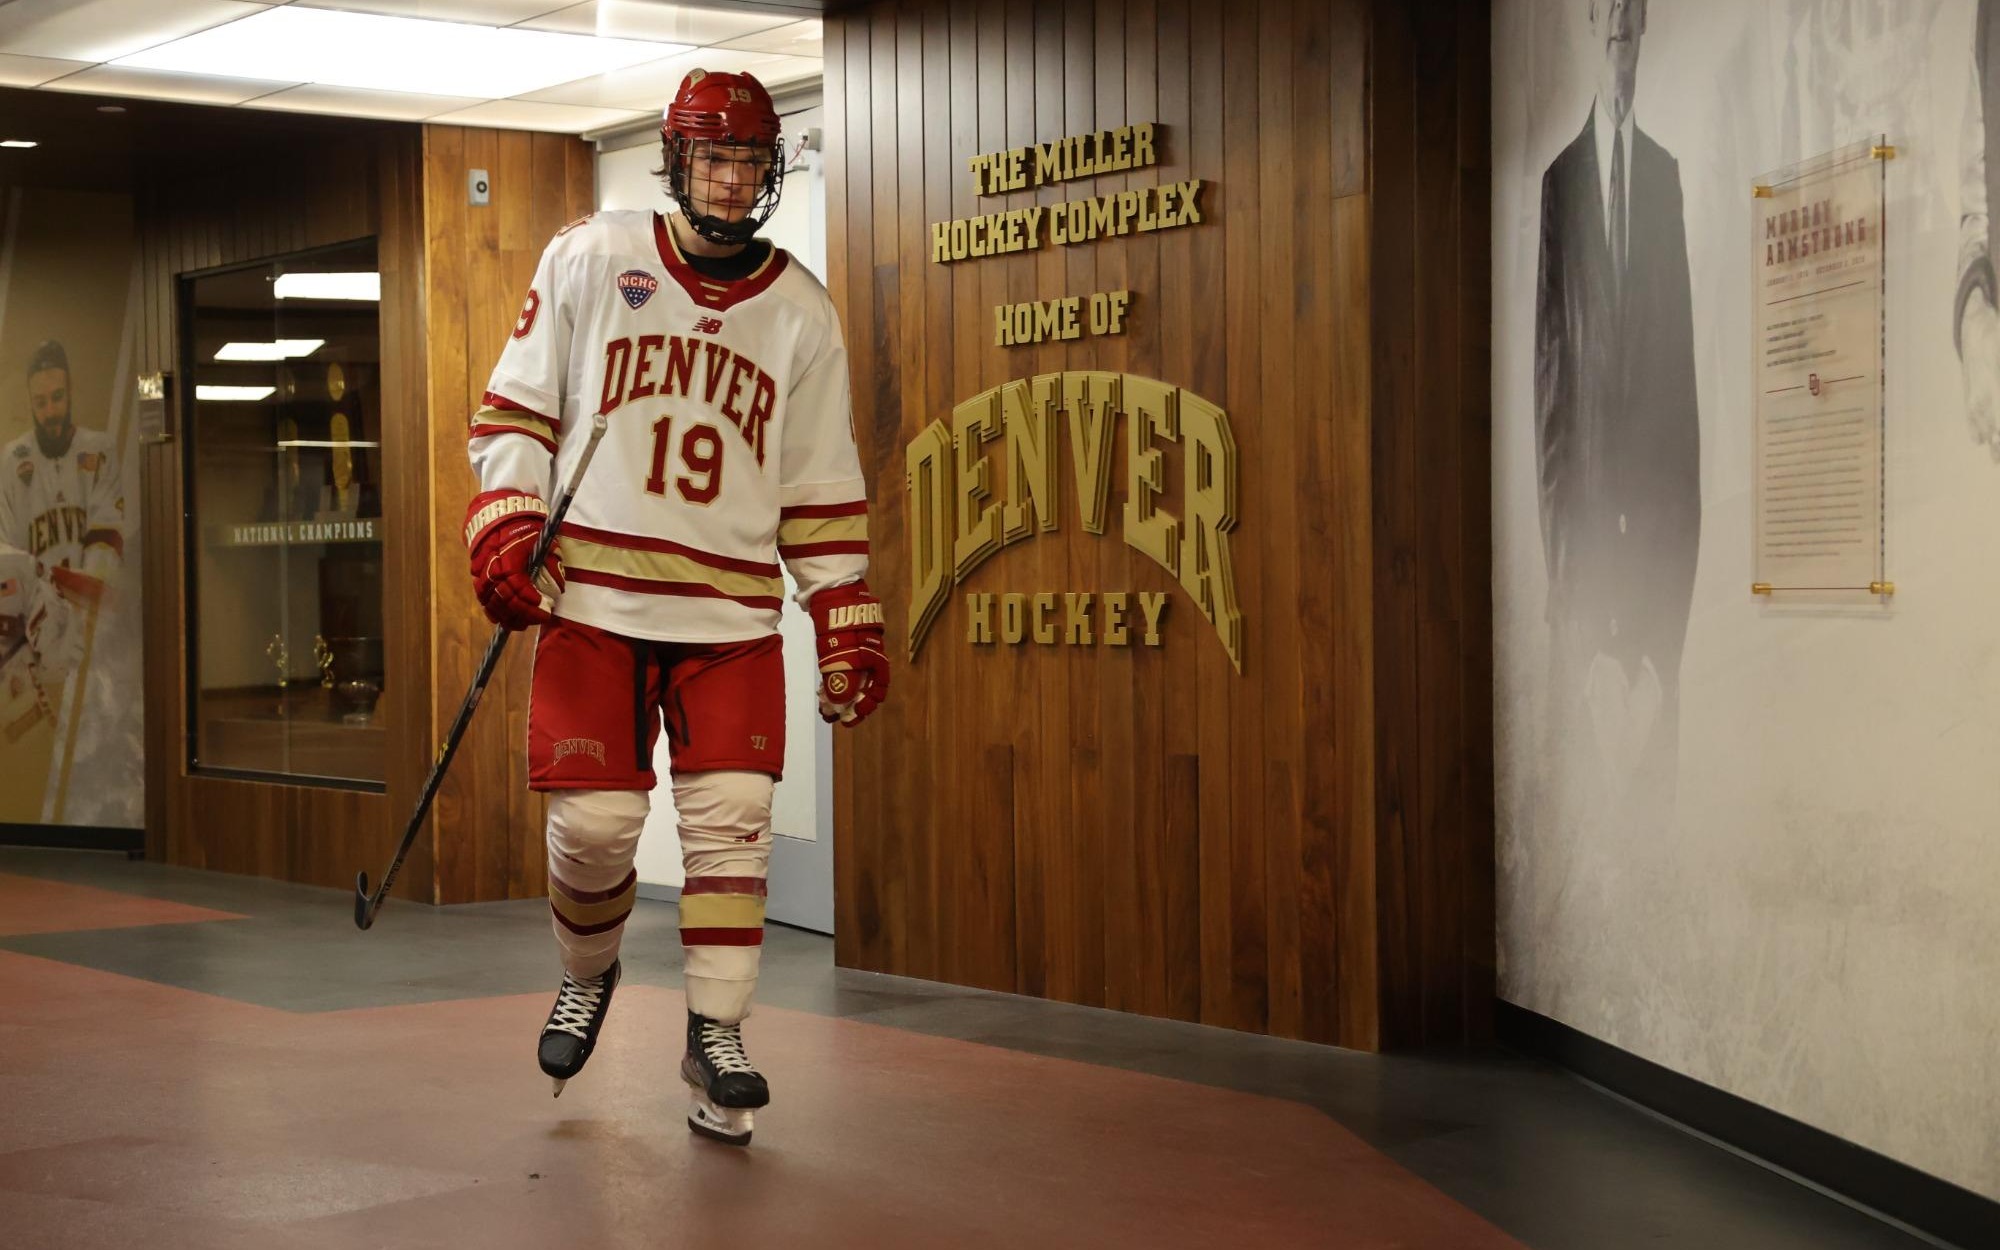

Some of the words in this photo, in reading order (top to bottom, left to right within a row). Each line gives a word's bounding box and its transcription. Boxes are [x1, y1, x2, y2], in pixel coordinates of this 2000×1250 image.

[728, 87, 752, 103] 19
[968, 147, 1026, 196] THE
[1034, 122, 1155, 186] MILLER
[932, 206, 1042, 263] HOCKEY
[1050, 179, 1201, 246] COMPLEX
[618, 275, 658, 291] NCHC
[512, 288, 541, 342] 9
[994, 297, 1080, 347] HOME
[1090, 290, 1129, 336] OF
[601, 334, 777, 474] DENVER
[644, 413, 725, 508] 19
[234, 525, 294, 543] NATIONAL
[300, 521, 373, 541] CHAMPIONS
[465, 496, 550, 548] WARRIO
[906, 371, 1242, 677] DENVER
[828, 637, 838, 648] 19
[967, 592, 1168, 646] HOCKEY
[553, 738, 606, 766] DENVER
